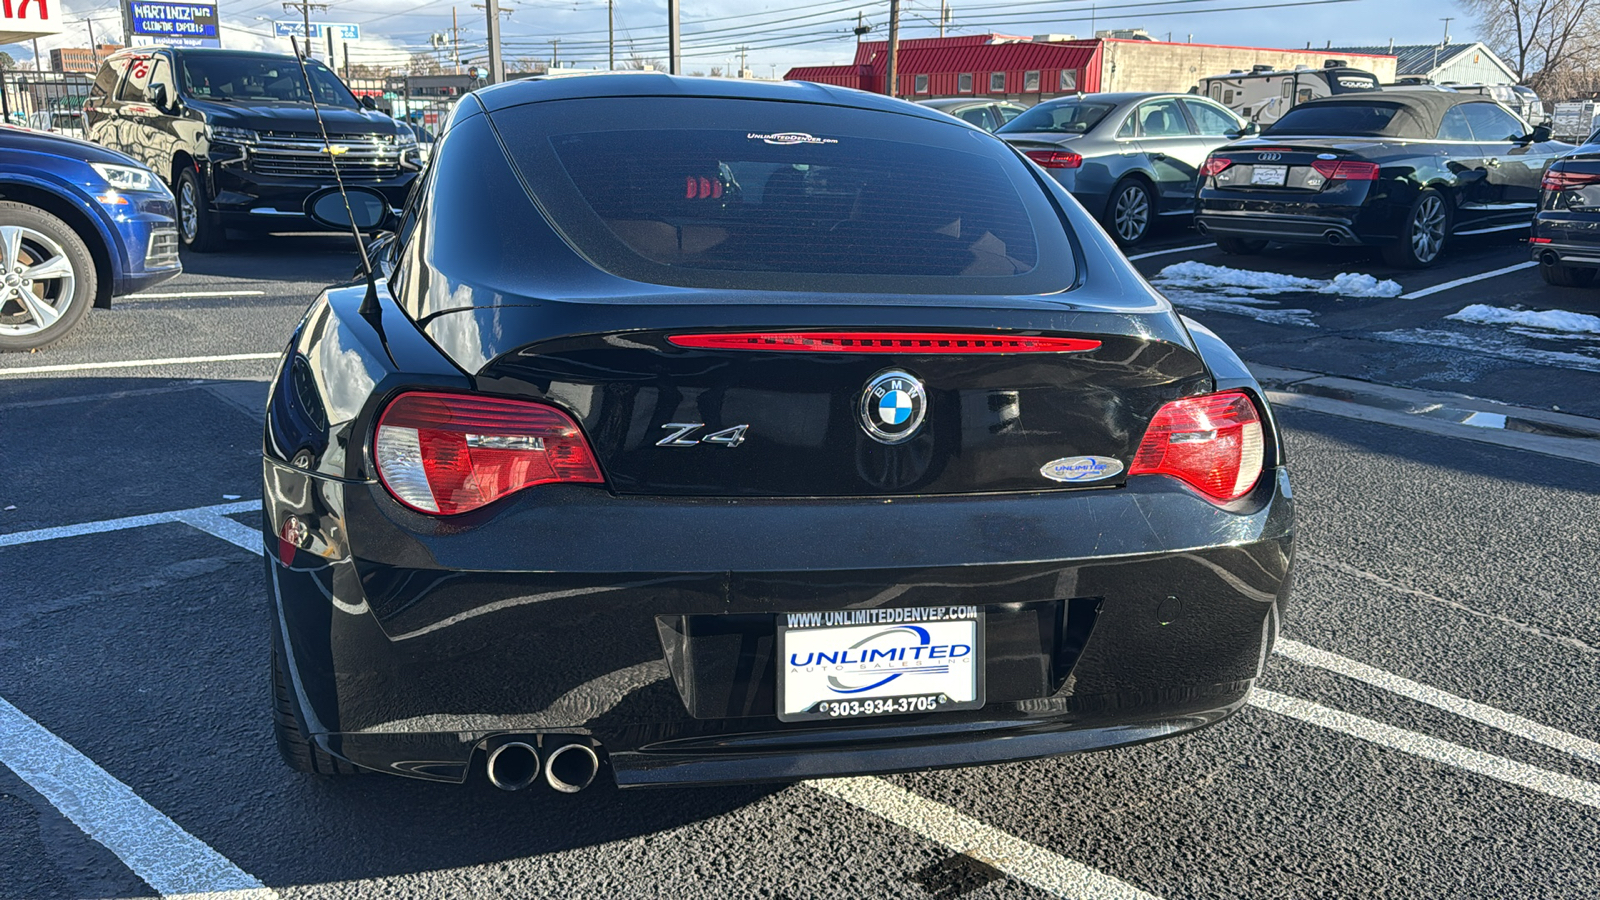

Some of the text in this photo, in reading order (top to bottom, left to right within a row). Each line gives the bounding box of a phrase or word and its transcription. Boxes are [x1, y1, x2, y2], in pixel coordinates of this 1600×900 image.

[1340, 80, 1374, 89] COUGAR
[873, 380, 919, 399] BMW
[655, 422, 750, 448] Z4
[787, 605, 978, 628] WWW.UNLIMITEDDENVER.COM
[790, 644, 971, 667] UNLIMITED
[790, 656, 970, 674] AUTO SALES INC
[829, 695, 937, 718] 303-934-3705
